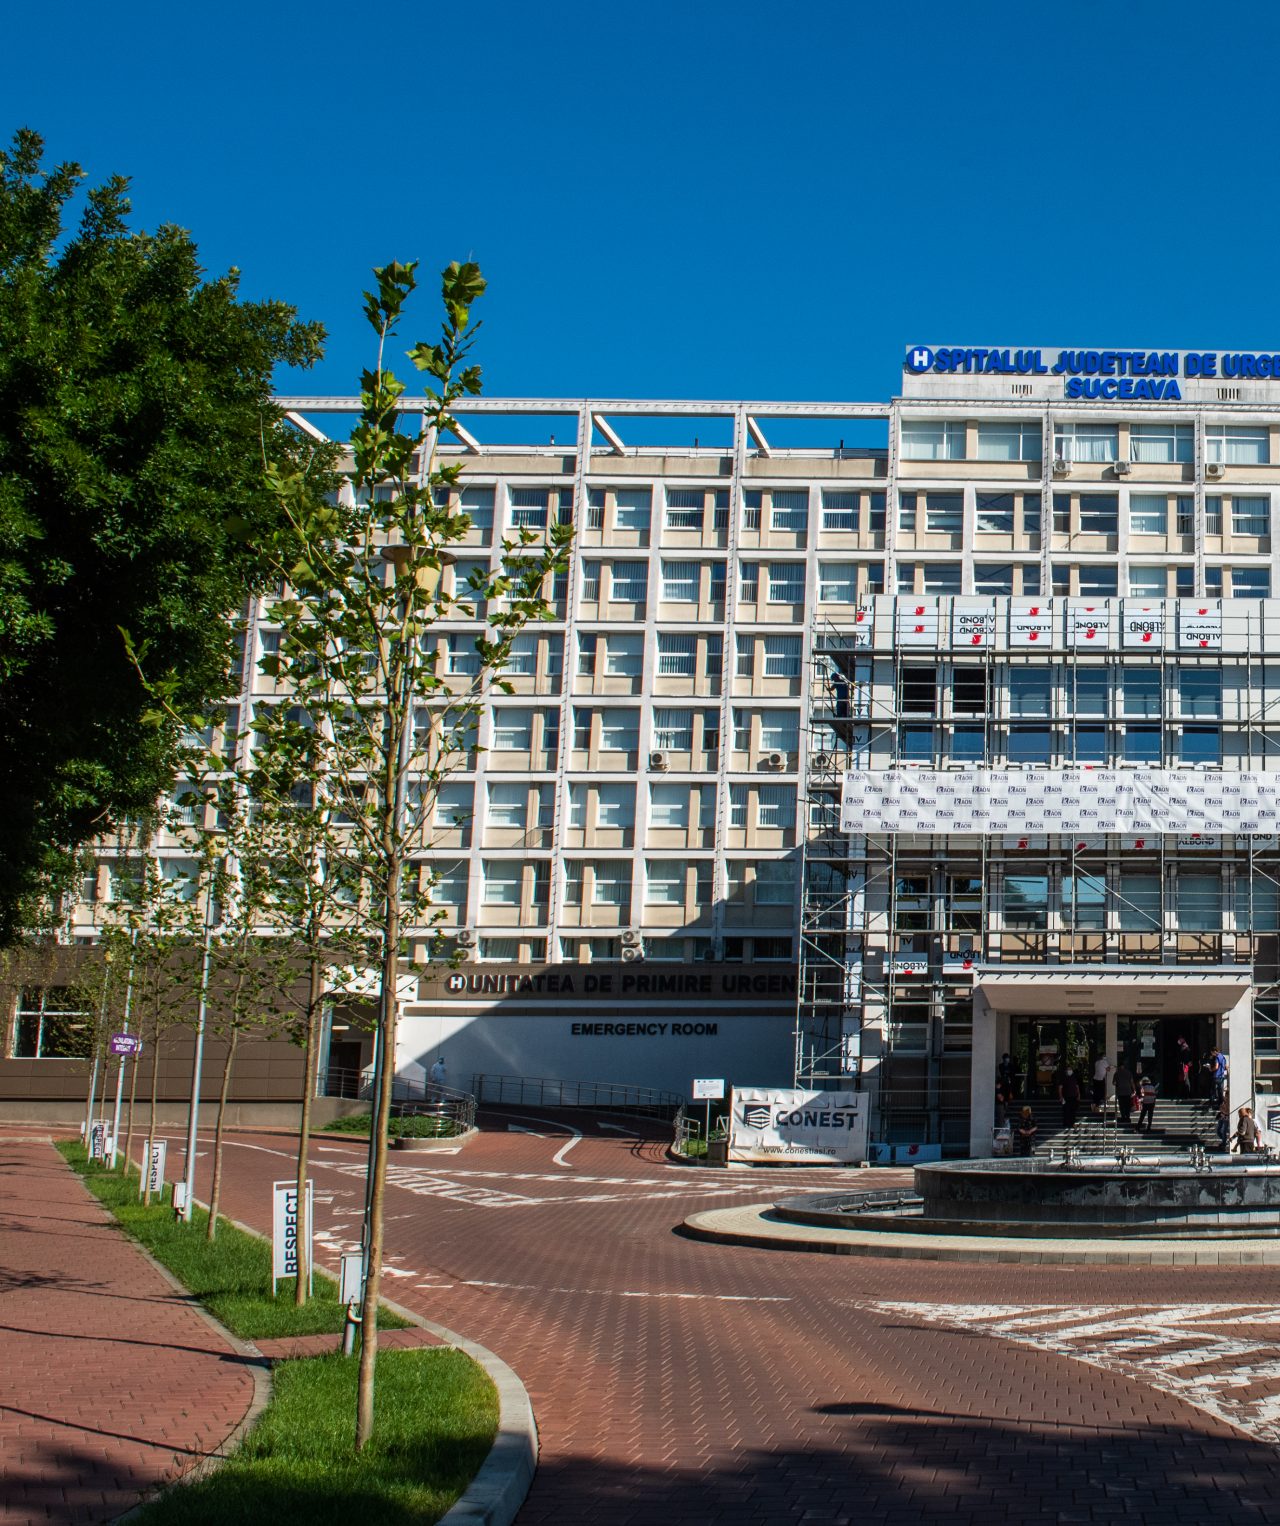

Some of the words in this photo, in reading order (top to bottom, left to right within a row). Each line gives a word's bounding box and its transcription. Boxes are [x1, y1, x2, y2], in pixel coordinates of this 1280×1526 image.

[935, 348, 1048, 373] SPITALUL
[1053, 351, 1179, 374] JUDETEAN
[1184, 353, 1217, 377] DE
[1067, 377, 1181, 400] SUCEAVA
[467, 975, 574, 992] UNITATEA
[584, 975, 612, 992] DE
[622, 975, 712, 993] PRIMIRE
[571, 1023, 668, 1035] EMERGENCY
[671, 1023, 718, 1035] ROOM
[776, 1110, 858, 1129] CONEST
